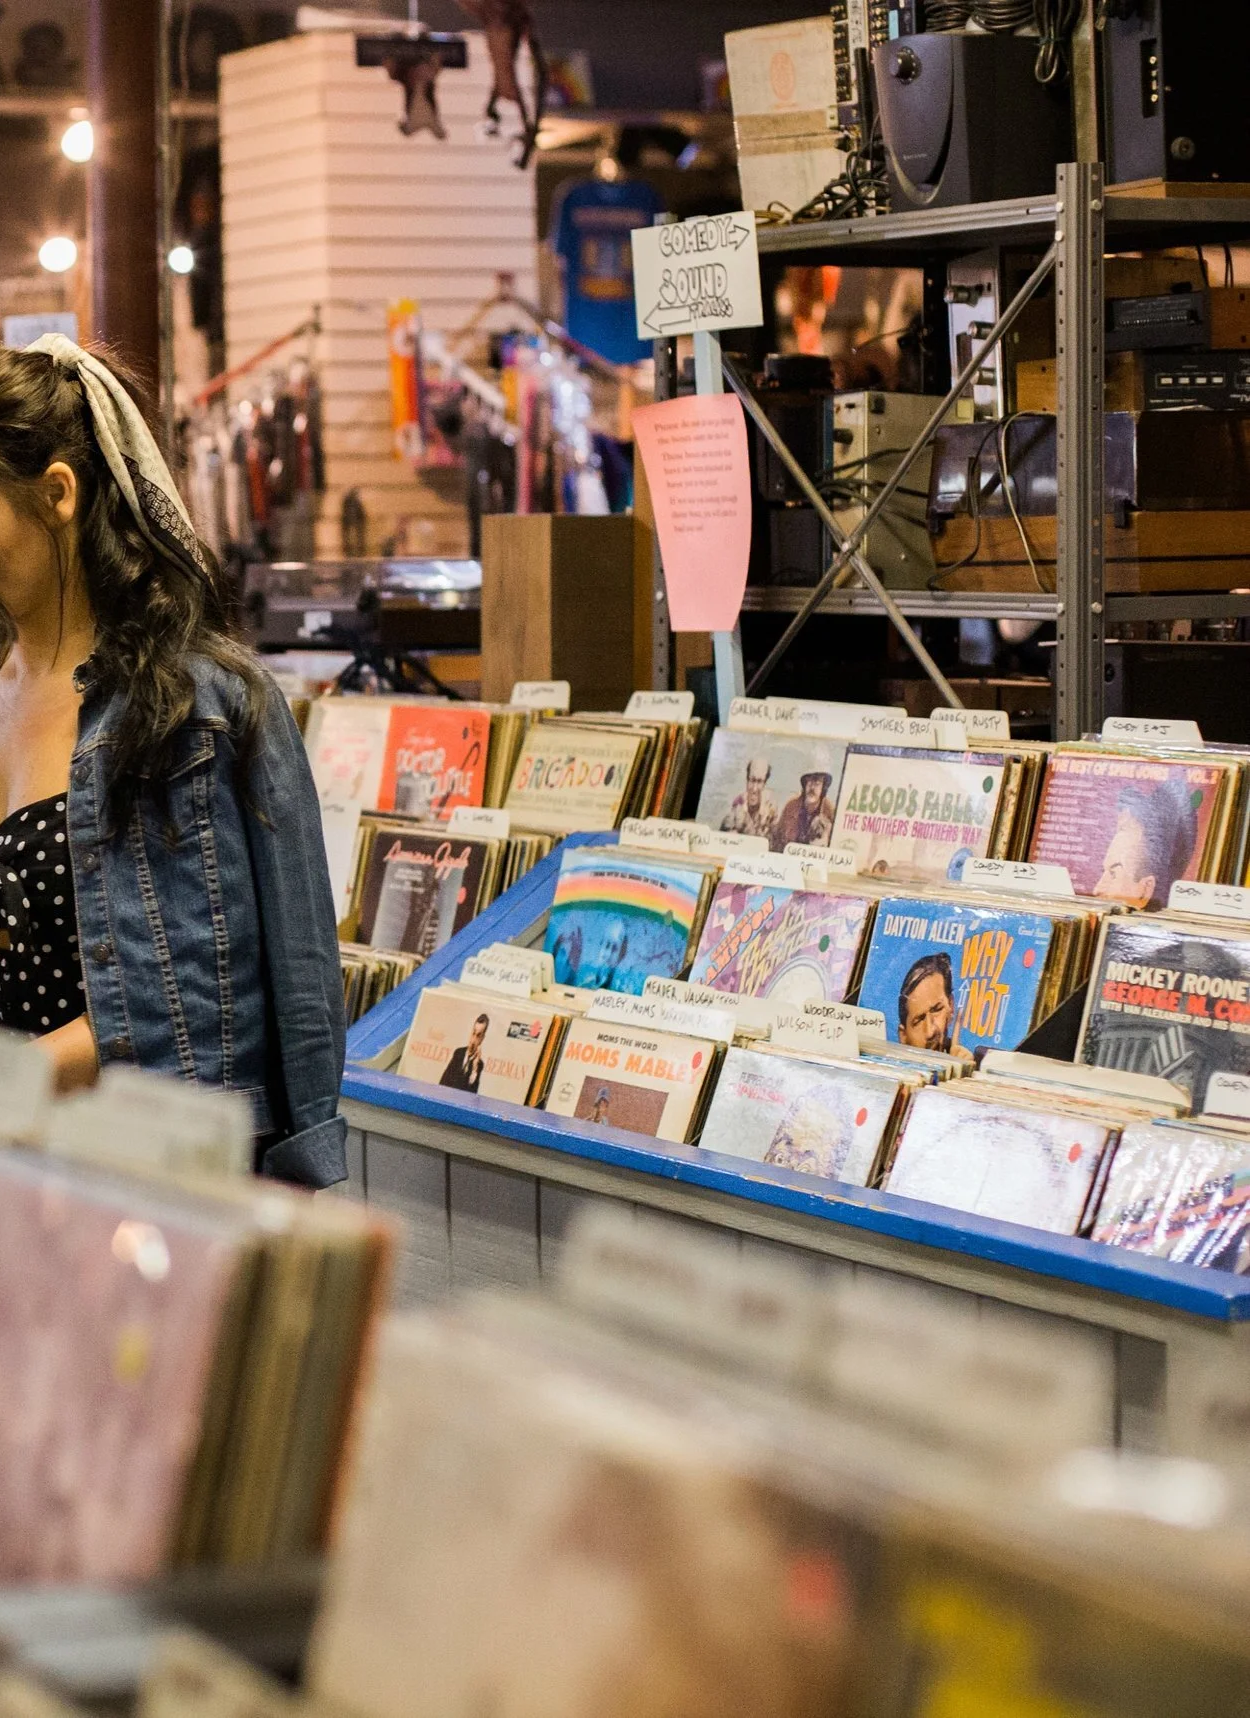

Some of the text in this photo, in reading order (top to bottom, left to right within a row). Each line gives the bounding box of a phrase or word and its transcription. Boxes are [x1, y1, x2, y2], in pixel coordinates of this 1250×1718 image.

[659, 216, 732, 257] COMEDY
[659, 263, 728, 305] SOUND
[861, 716, 905, 734] SMOTHERS
[972, 712, 1002, 731] RUSTY
[517, 754, 629, 790] BRIGADOON
[845, 783, 988, 826] AESOP'S FABLES
[843, 813, 983, 845] THE SMOTHERS BROTHERS WAY
[828, 853, 854, 865] ALAN
[973, 859, 1005, 872] COMEDY
[702, 893, 775, 987] AMPOON
[883, 913, 966, 946] DAYTON ALLEN
[960, 929, 1014, 988] WHY
[645, 981, 681, 1003] MEADER,
[1106, 961, 1250, 1002] MICKEY ROONE
[594, 995, 628, 1013] MABLEY,
[631, 1003, 655, 1018] MOMS
[1102, 980, 1182, 1012] GEORGE
[1185, 994, 1209, 1017] M.
[776, 1015, 844, 1043] WILSON, FLIP
[1100, 1000, 1123, 1012] WITH
[1123, 1003, 1140, 1015] VAN
[1140, 1005, 1192, 1024] ALEXANDER
[1192, 1015, 1212, 1028] AND
[410, 1041, 451, 1064] SHELLEY
[597, 1032, 658, 1051] MOMS THE WORD
[485, 1056, 529, 1080] BERMAN
[565, 1041, 704, 1084] MOMS MABLEY
